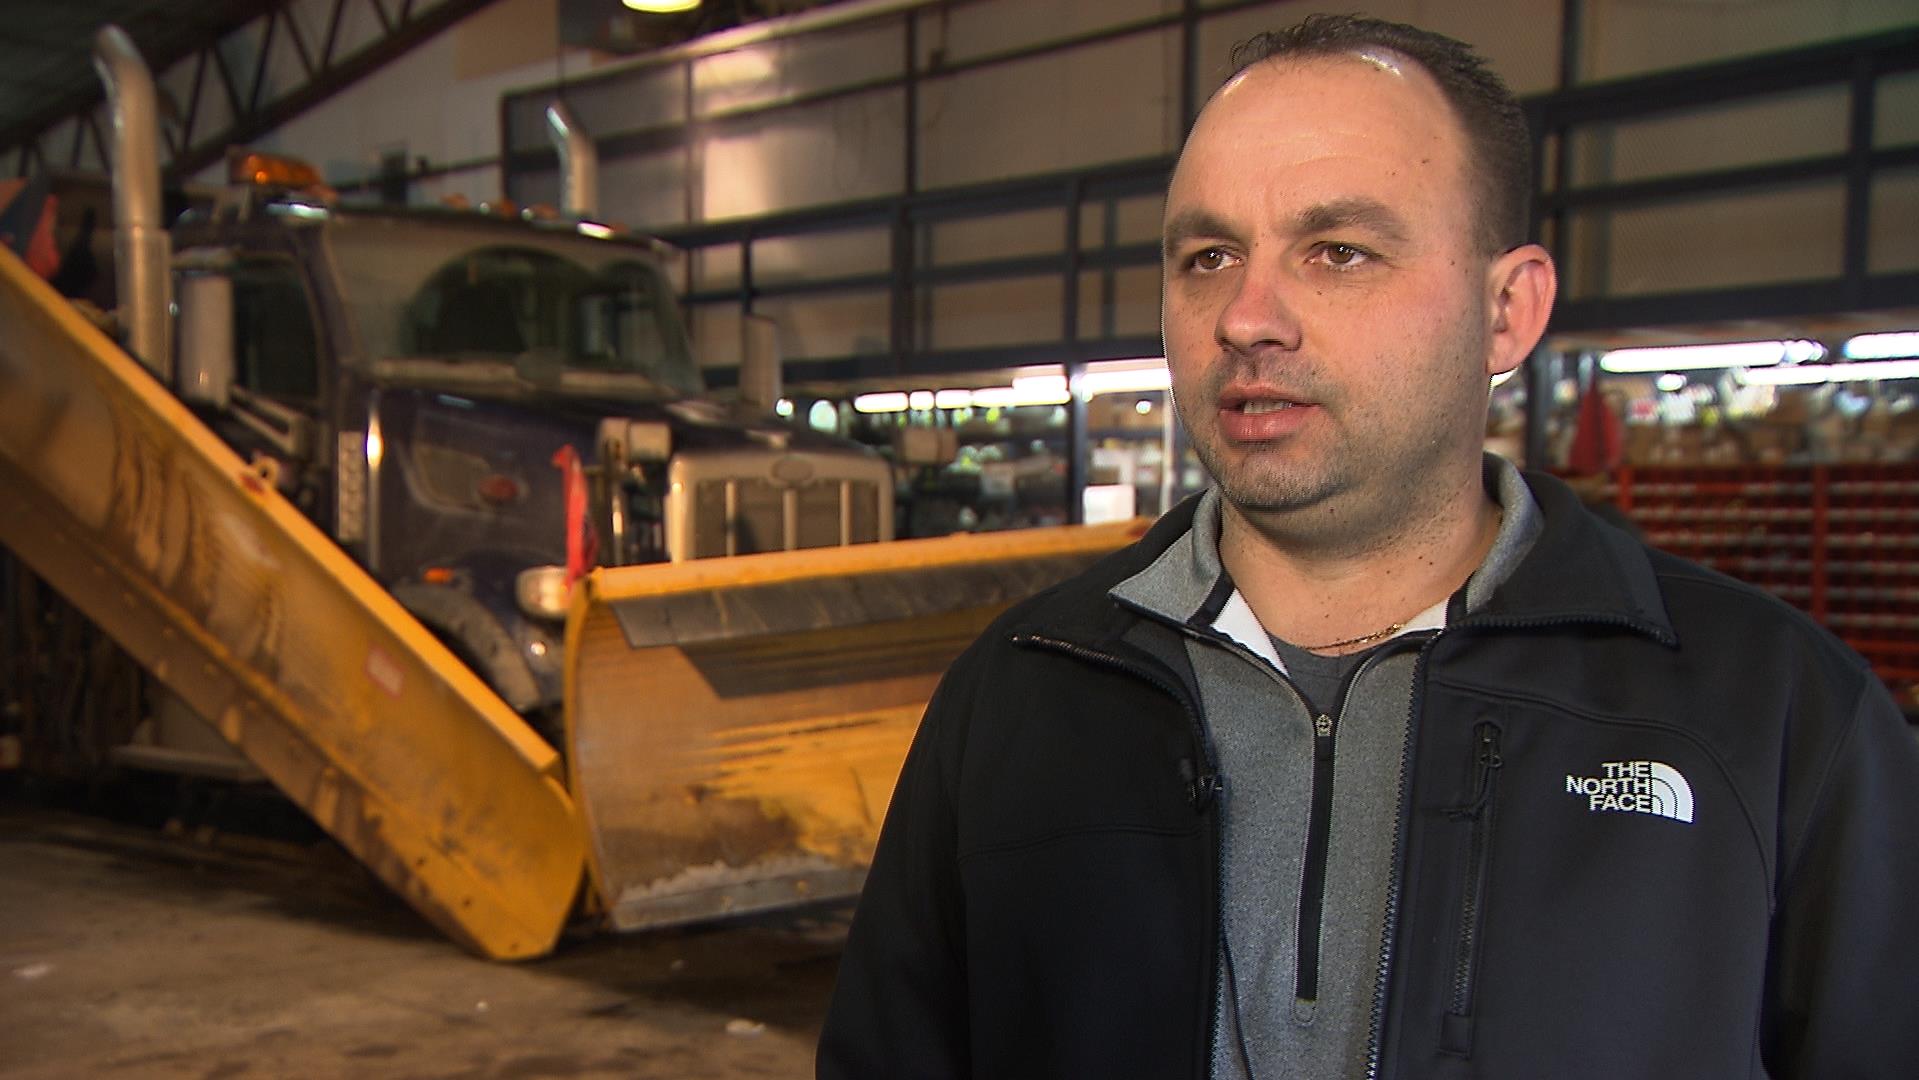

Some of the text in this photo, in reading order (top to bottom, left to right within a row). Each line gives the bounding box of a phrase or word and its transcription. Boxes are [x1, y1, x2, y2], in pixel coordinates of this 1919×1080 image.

[1601, 761, 1650, 778] THE
[1566, 775, 1651, 794] NORTH
[1590, 794, 1651, 813] FACE
